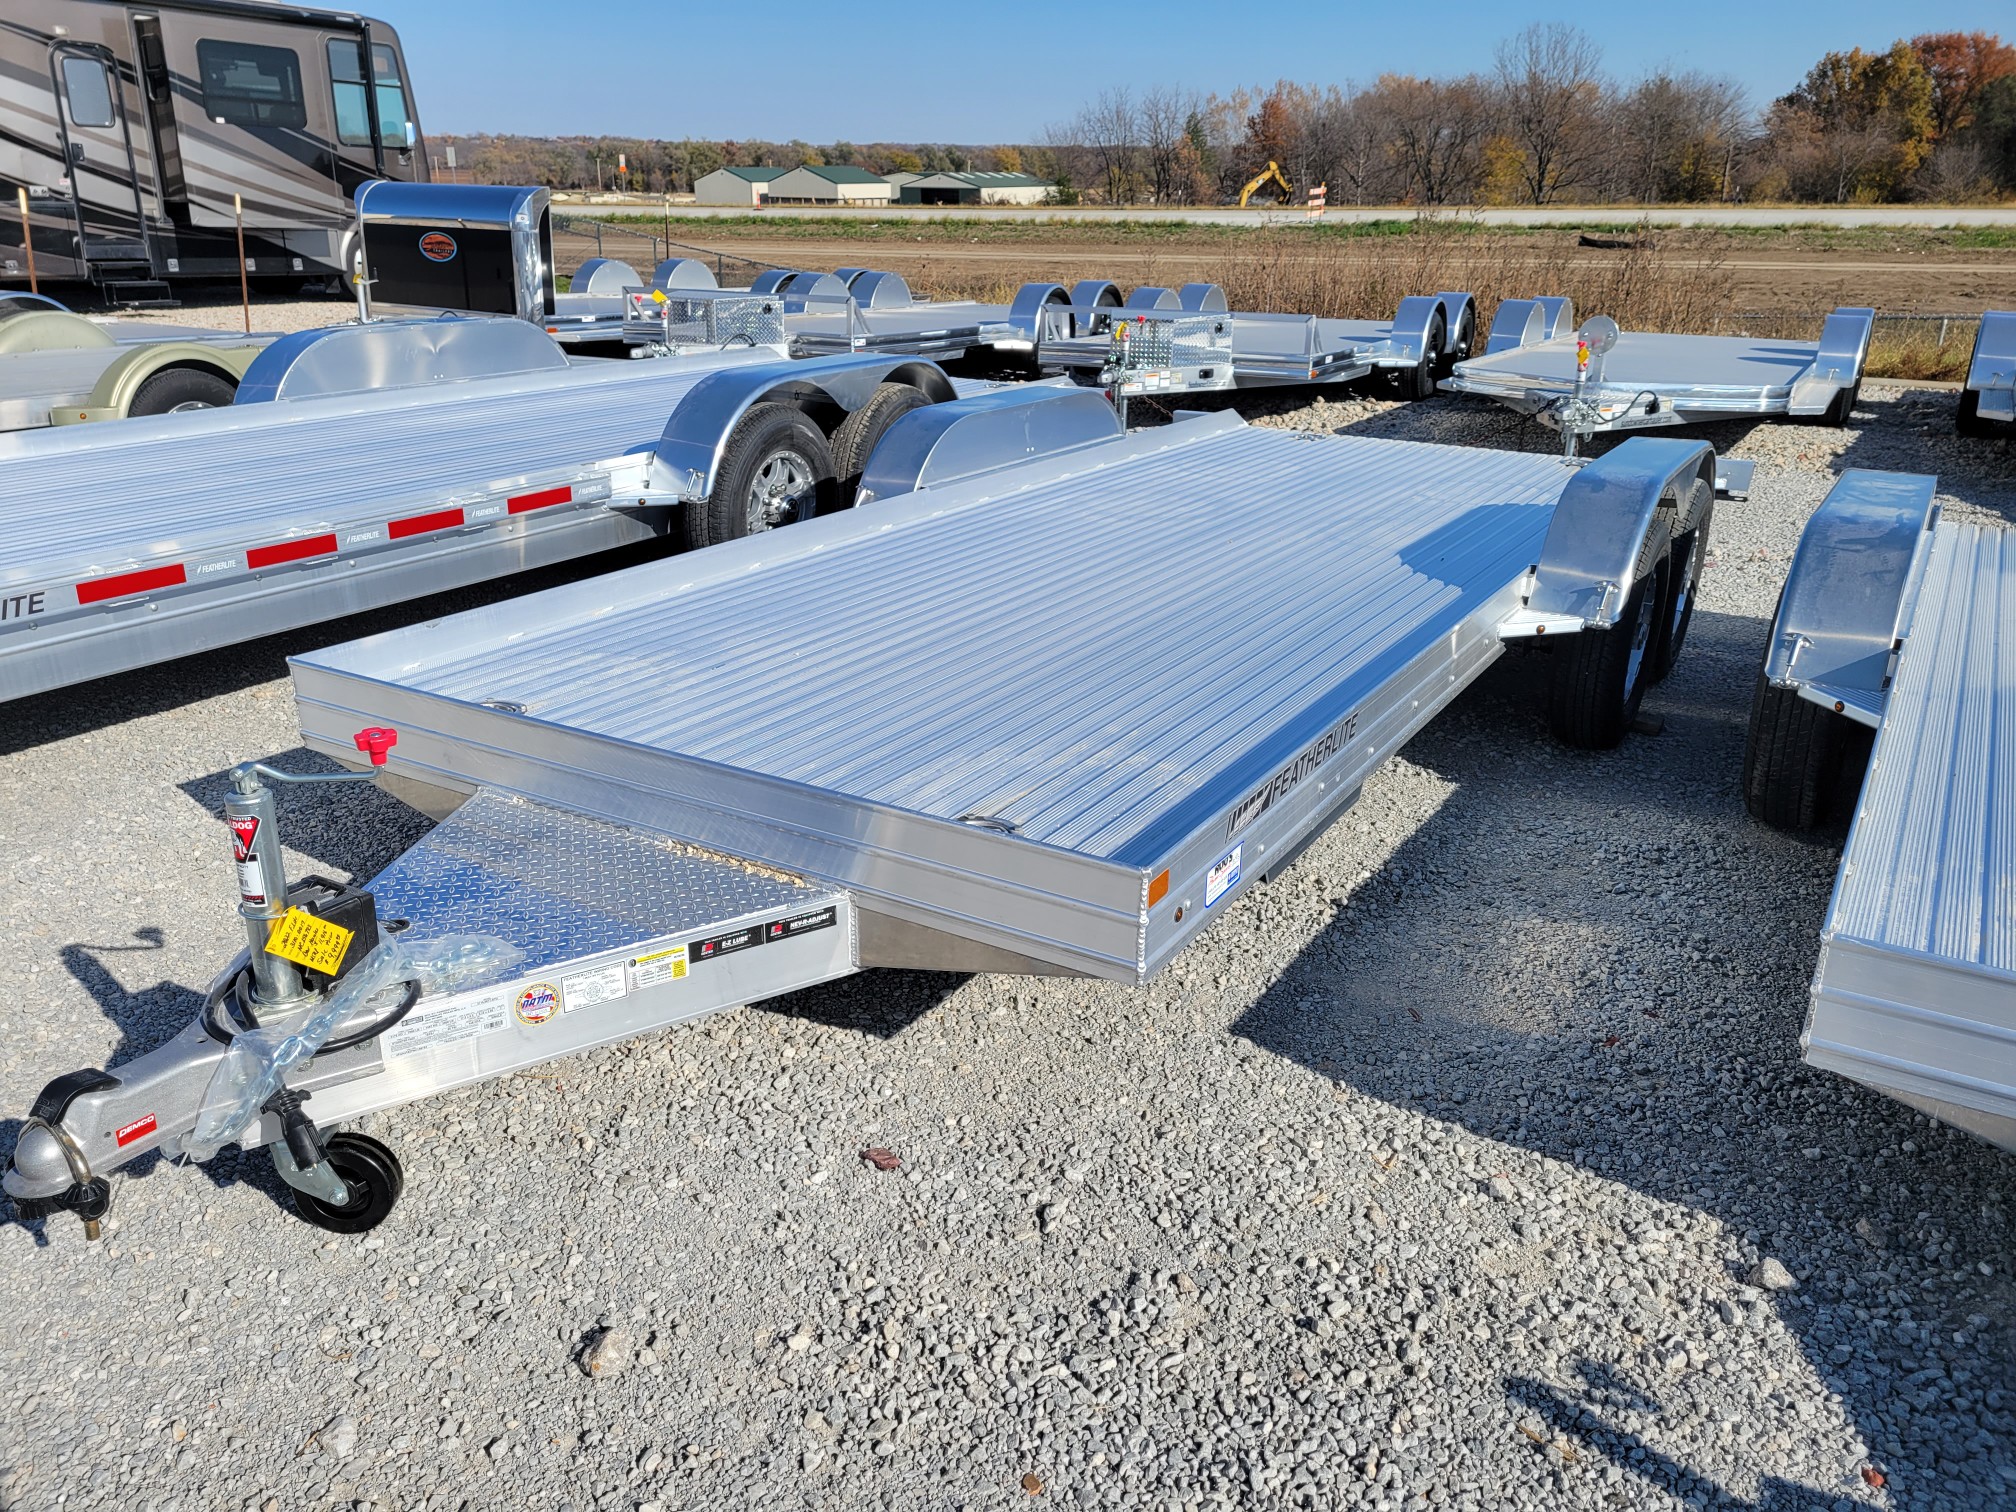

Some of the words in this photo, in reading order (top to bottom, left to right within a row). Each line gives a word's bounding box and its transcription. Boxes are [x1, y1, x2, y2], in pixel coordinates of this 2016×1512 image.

[475, 506, 500, 517] FEATHERLITE
[350, 530, 380, 544] FEATHERLITE
[202, 559, 237, 574] FEATHERLITE
[1271, 712, 1359, 805] FEATHERLITE
[118, 1115, 155, 1139] DEMCO
